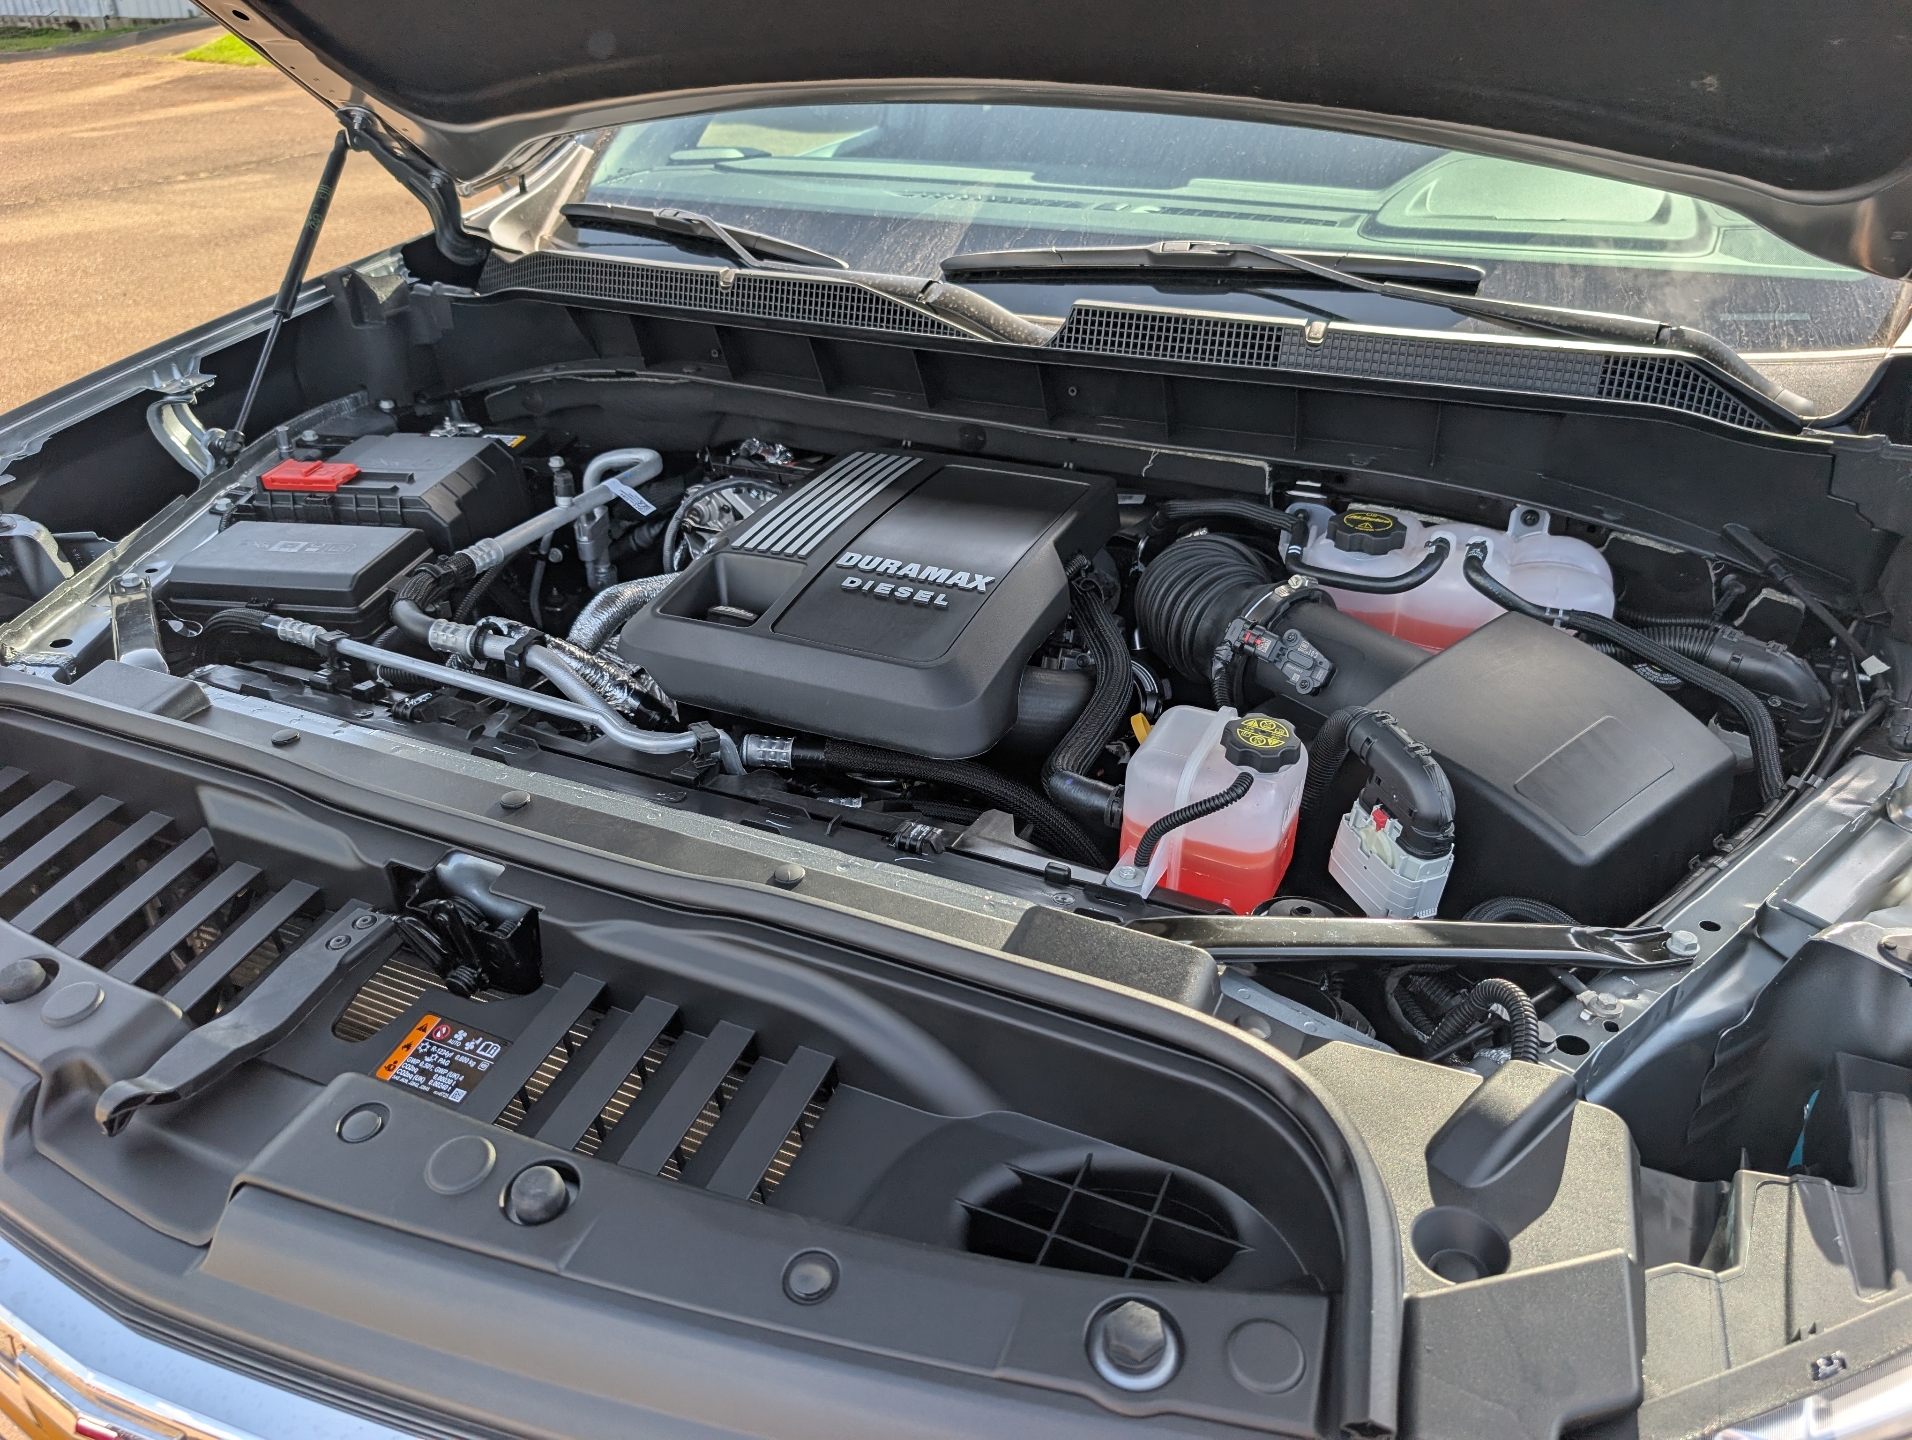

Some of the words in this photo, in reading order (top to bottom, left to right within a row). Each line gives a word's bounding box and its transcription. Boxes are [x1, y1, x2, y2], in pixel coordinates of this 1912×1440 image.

[836, 551, 995, 593] DURAMAX
[841, 576, 948, 608] DIESEL
[447, 1038, 462, 1047] AUTO
[430, 1045, 454, 1058] R-1234yf
[406, 1056, 421, 1065] GWP
[434, 1066, 449, 1075] GWP
[437, 1057, 451, 1066] PAG
